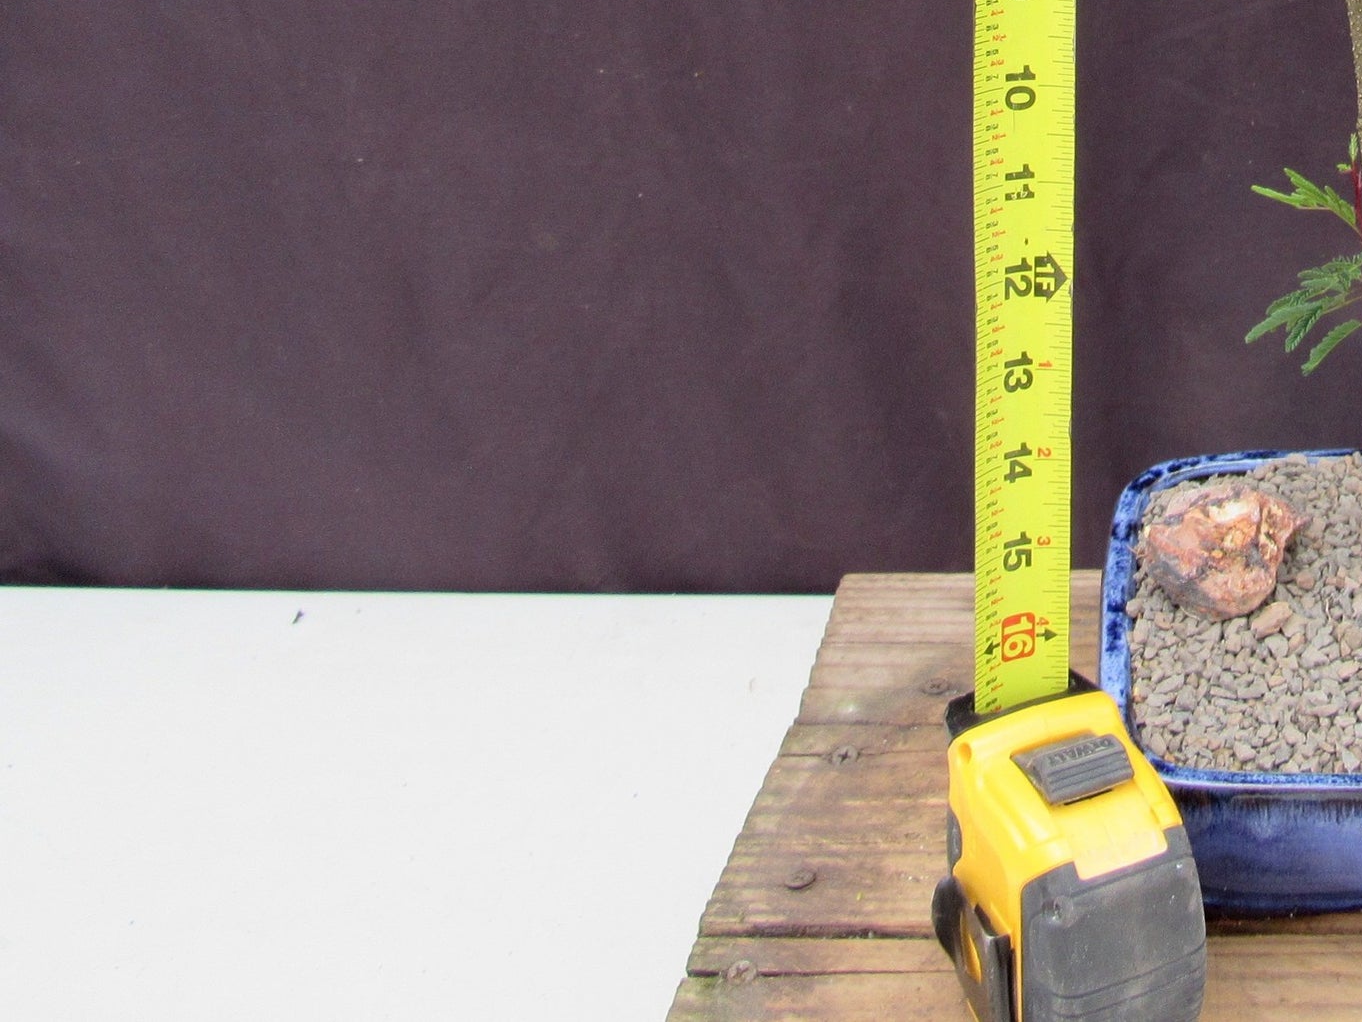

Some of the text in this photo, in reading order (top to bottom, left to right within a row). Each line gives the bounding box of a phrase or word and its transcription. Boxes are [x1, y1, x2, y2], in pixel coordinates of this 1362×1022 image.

[1005, 65, 1036, 111] 10
[1005, 164, 1035, 201] 11
[1005, 257, 1032, 300] 12
[1035, 263, 1055, 292] 1F
[1004, 351, 1033, 393] 13
[1038, 360, 1052, 368] 1
[1004, 442, 1032, 483] 14
[1037, 447, 1052, 458] 2
[1003, 531, 1032, 572] 15
[1037, 536, 1050, 546] 3
[1003, 616, 1033, 658] 16
[1036, 617, 1050, 627] 4
